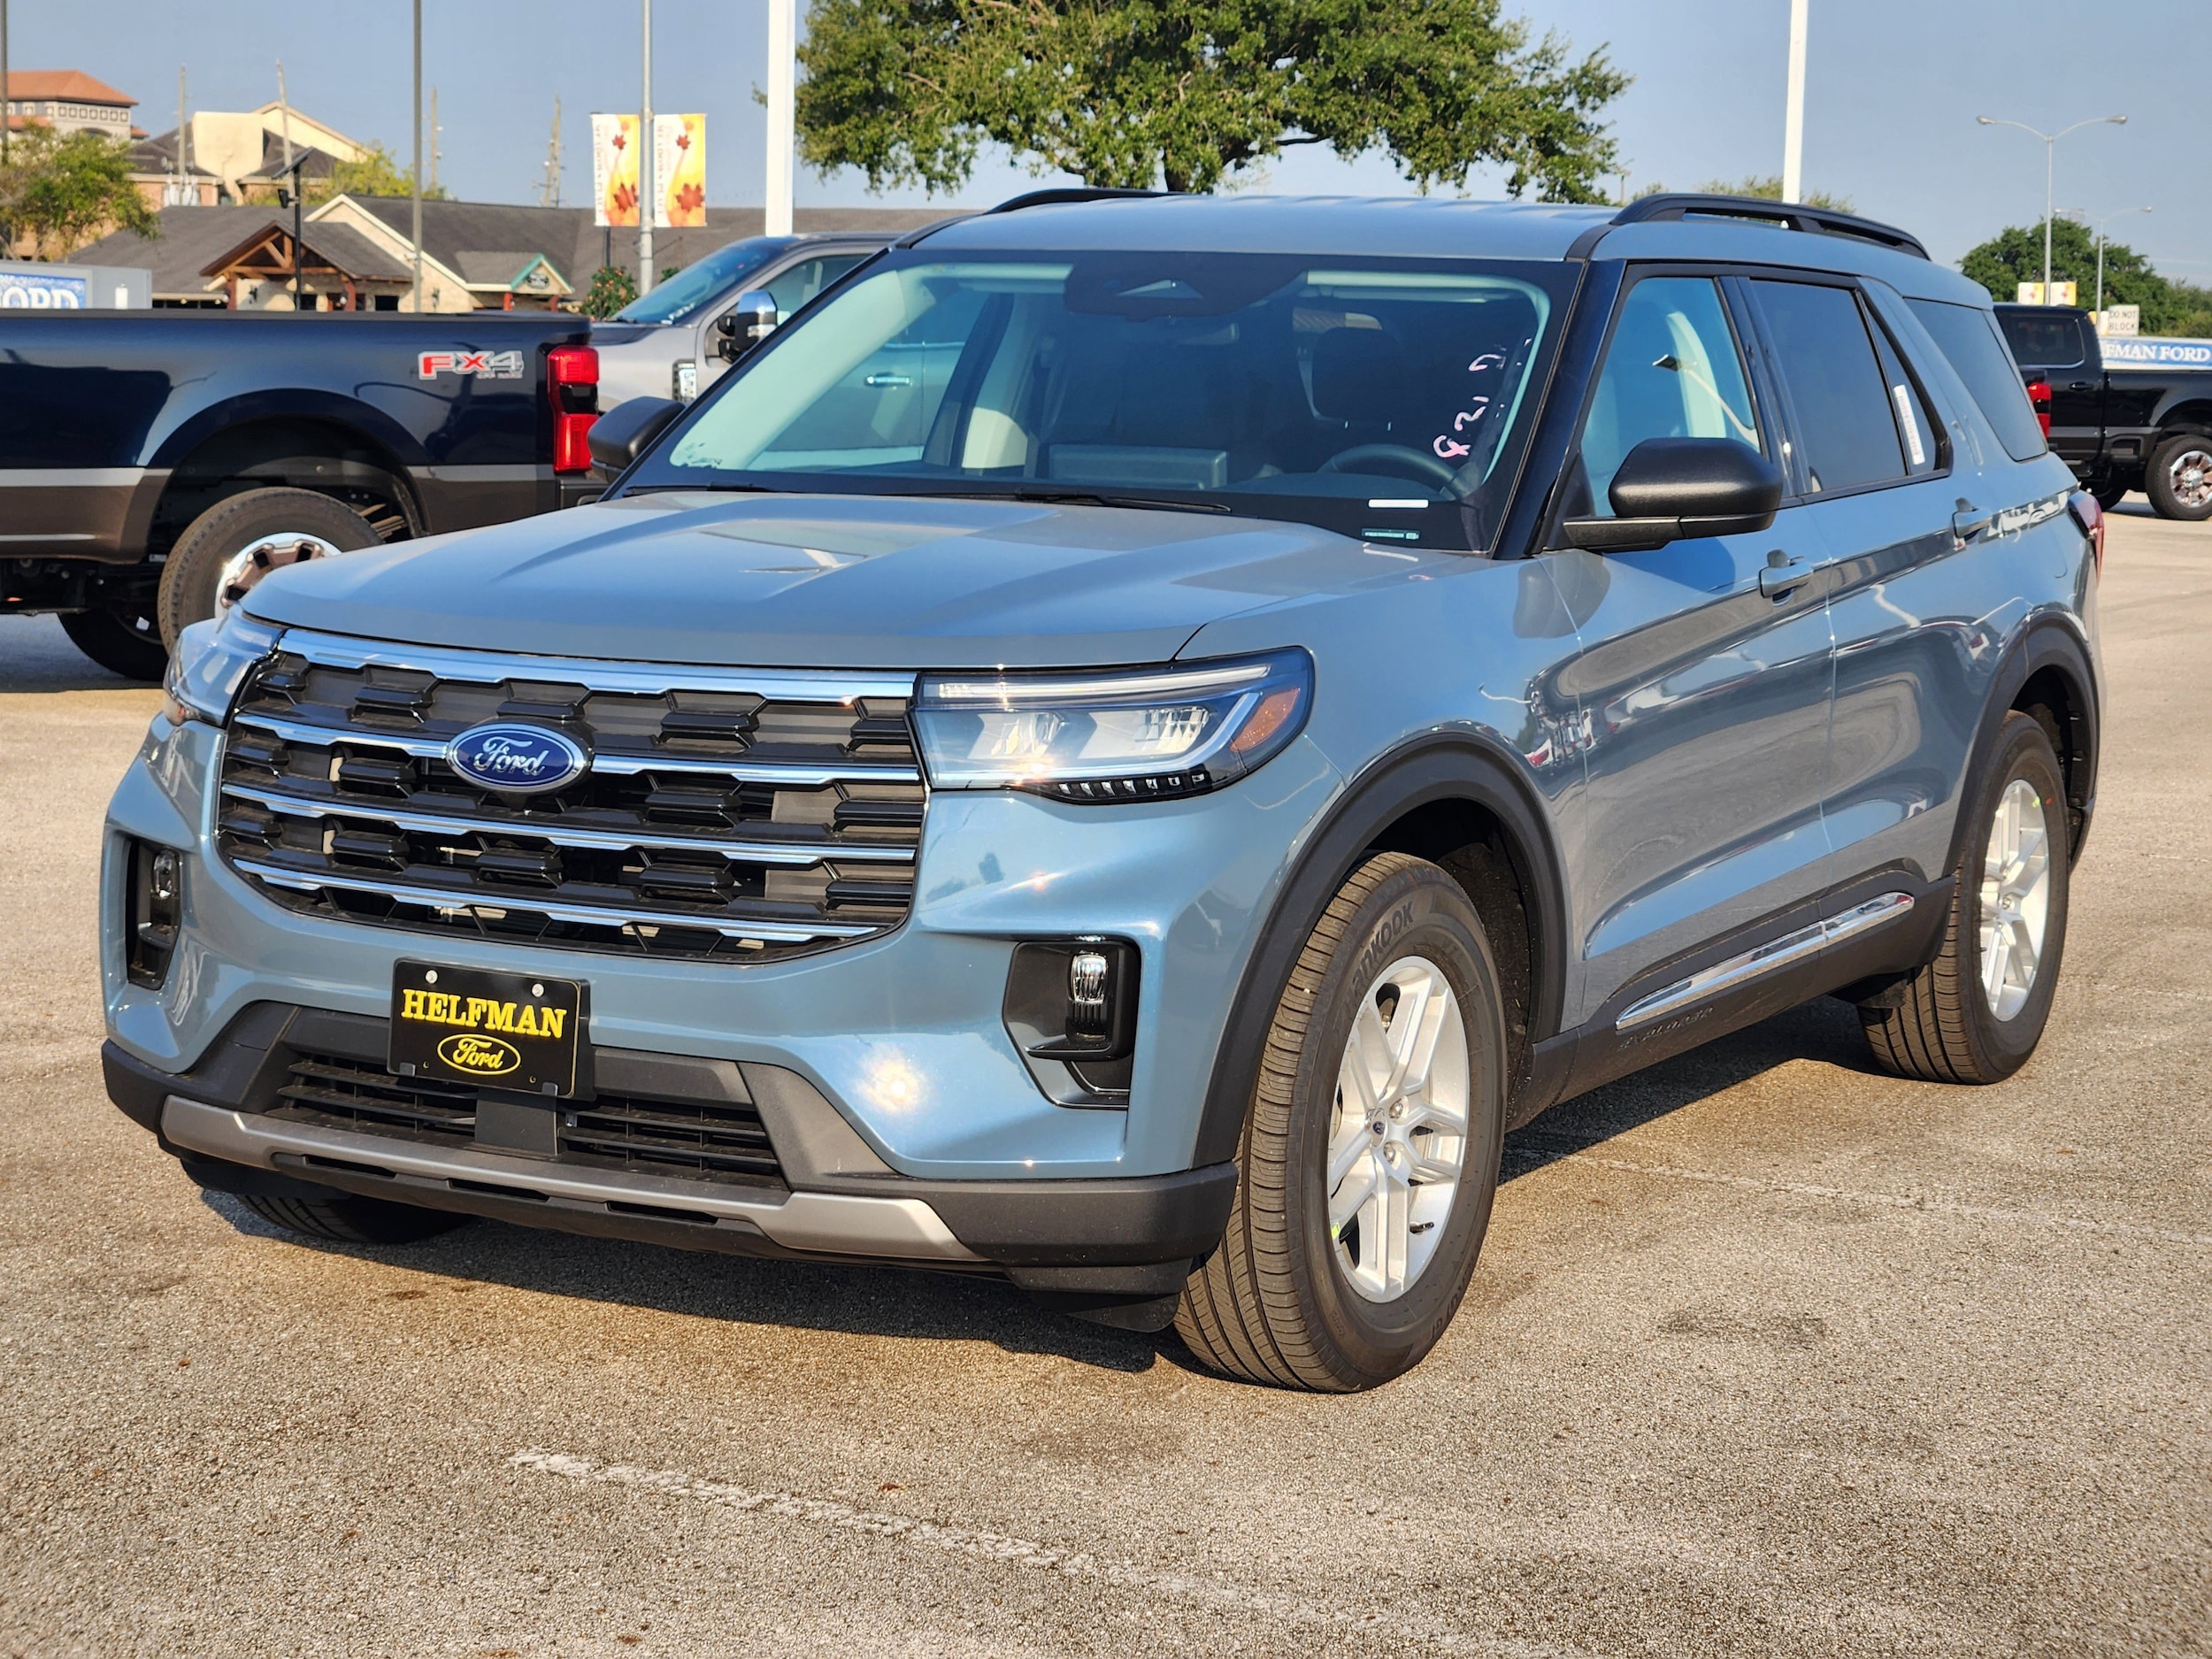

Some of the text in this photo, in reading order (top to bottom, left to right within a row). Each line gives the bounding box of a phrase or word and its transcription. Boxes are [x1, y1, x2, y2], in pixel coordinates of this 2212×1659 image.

[0, 286, 79, 309] ORD
[2109, 322, 2137, 331] BLOCK
[418, 350, 524, 380] FX4
[2102, 343, 2211, 362] FMAN FORD
[473, 735, 549, 776] Ford
[401, 988, 567, 1039] HELFMAN
[452, 1037, 505, 1069] Ford
